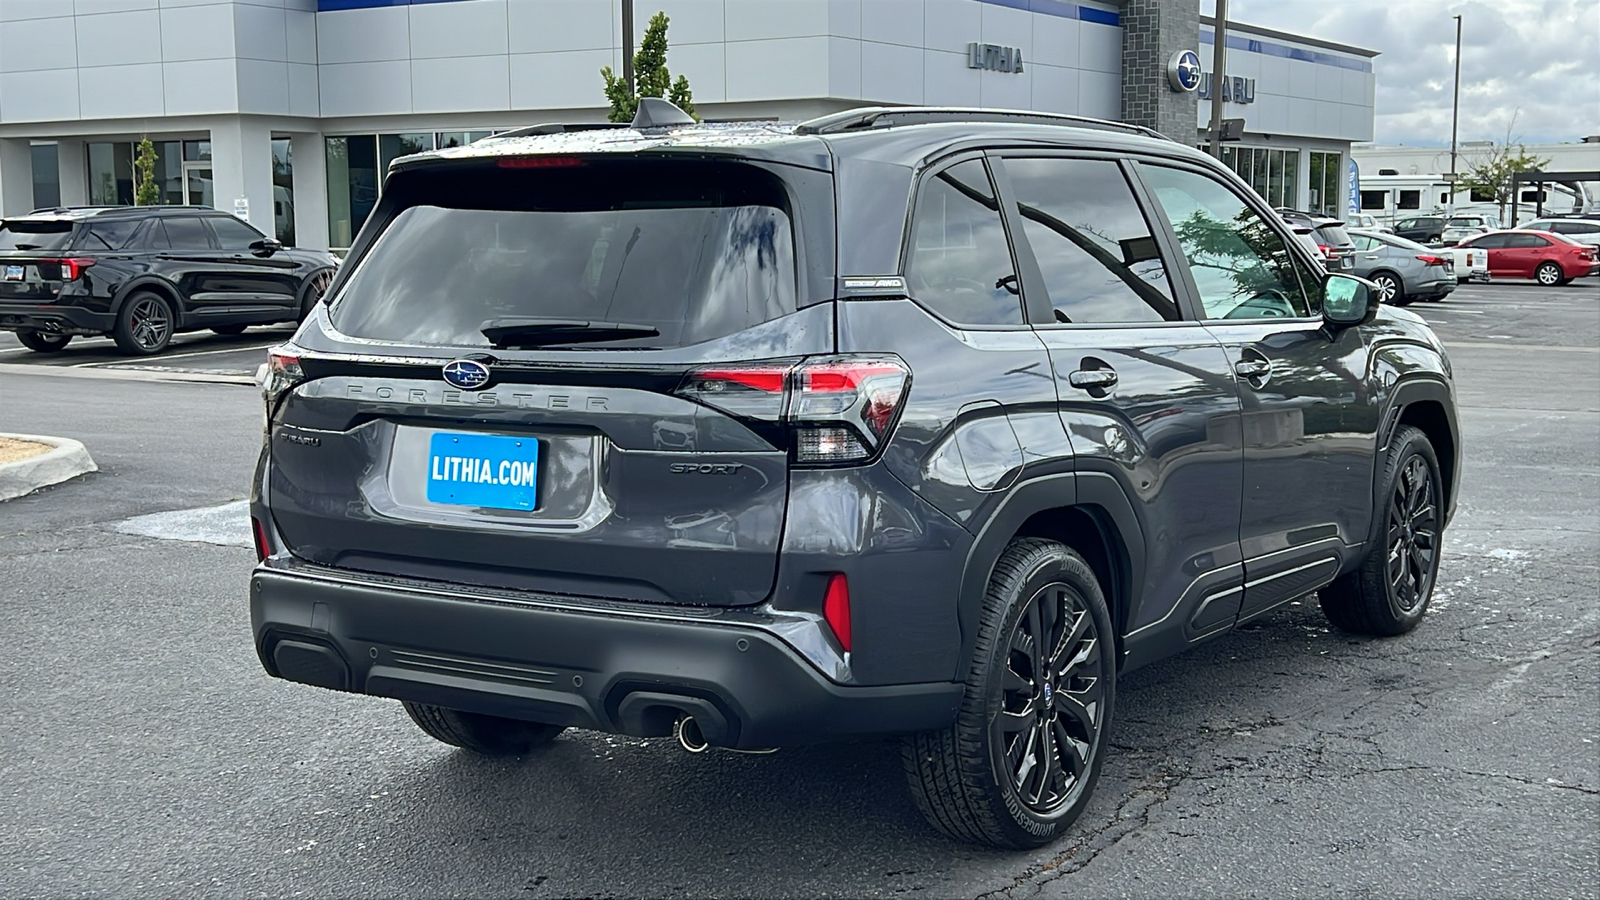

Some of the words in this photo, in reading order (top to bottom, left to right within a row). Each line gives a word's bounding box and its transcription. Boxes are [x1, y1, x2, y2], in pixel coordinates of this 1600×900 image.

[969, 43, 1024, 73] LITHIA
[1198, 72, 1255, 104] UARU
[346, 384, 610, 411] FORESTER
[281, 433, 321, 447] SUBARU
[432, 455, 535, 487] LITHIA.COM
[670, 462, 743, 475] SPORT
[1001, 787, 1057, 837] BRIDGESTONE
